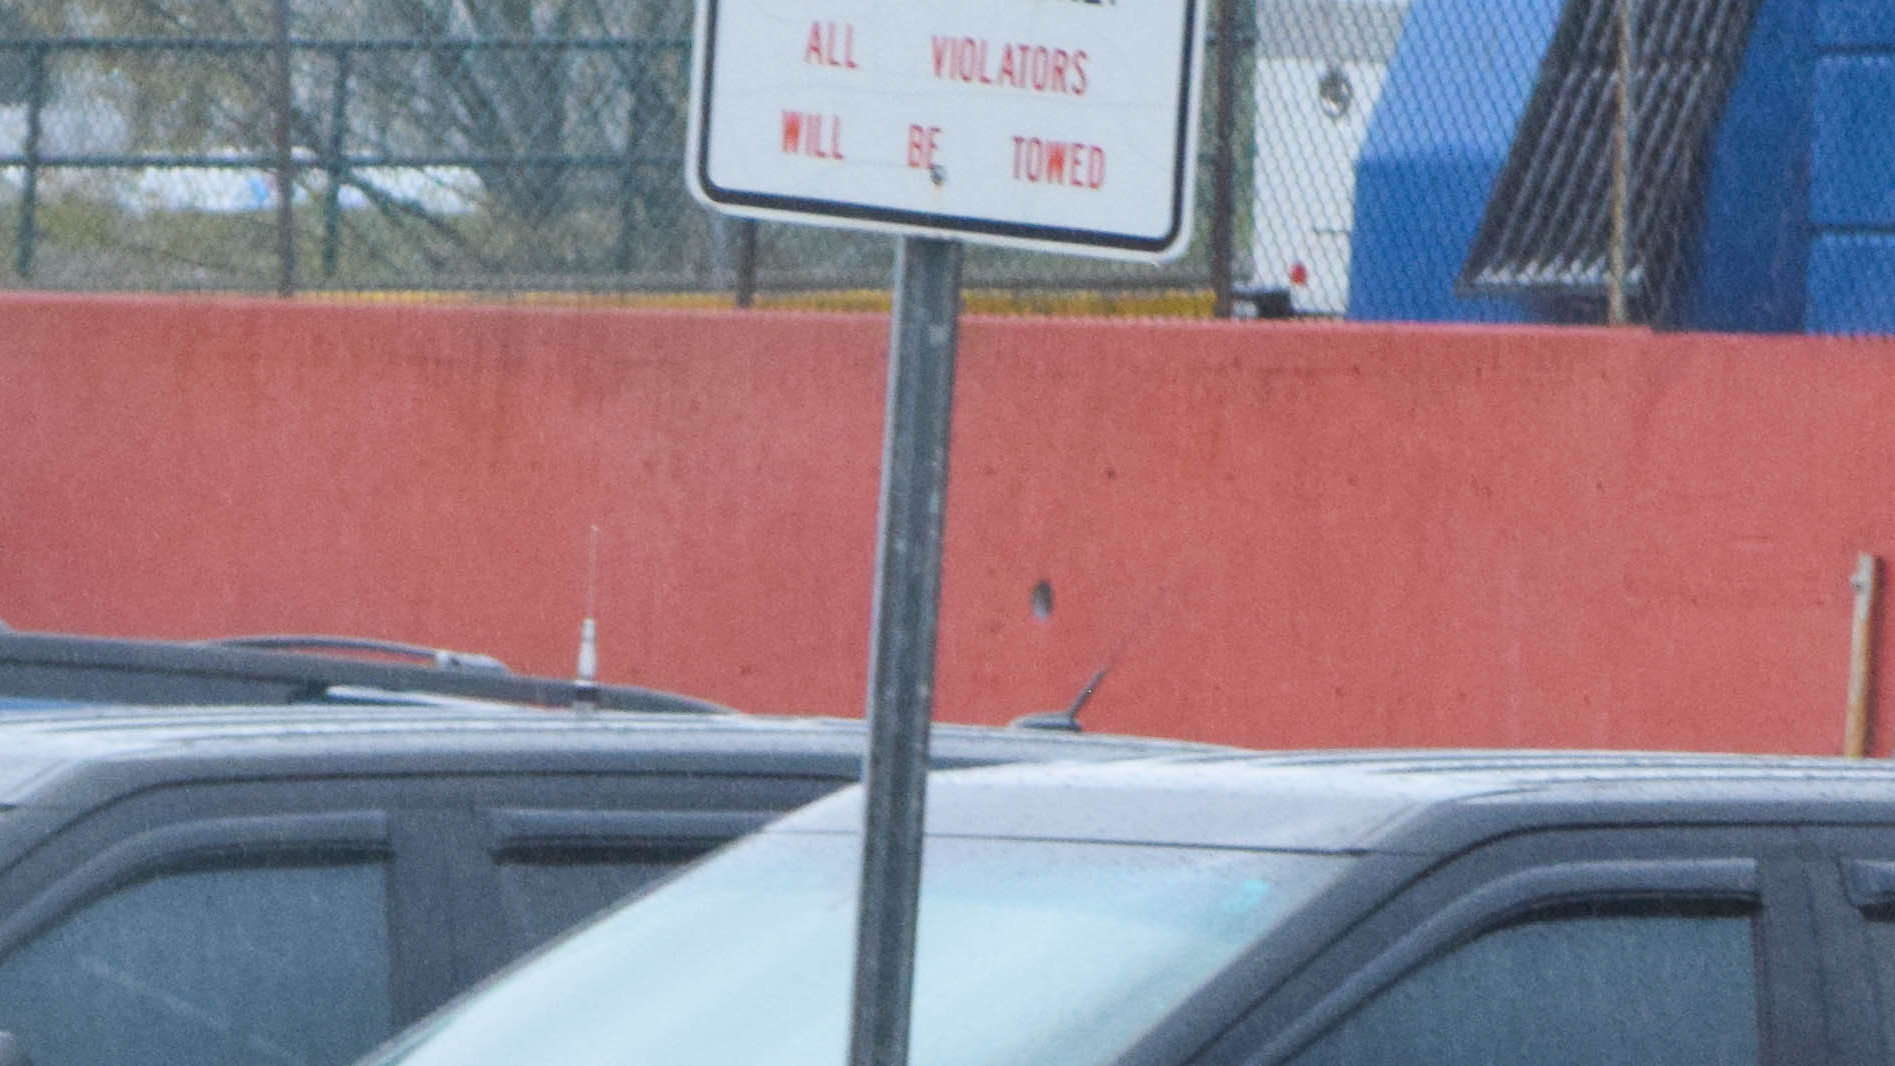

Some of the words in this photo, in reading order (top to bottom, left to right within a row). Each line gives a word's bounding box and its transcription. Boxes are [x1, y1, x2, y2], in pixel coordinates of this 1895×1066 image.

[805, 21, 858, 69] ALL
[932, 36, 1089, 95] VIOLATORS
[782, 110, 845, 160] WILL
[908, 124, 943, 169] BE
[1012, 136, 1105, 190] TOWED
